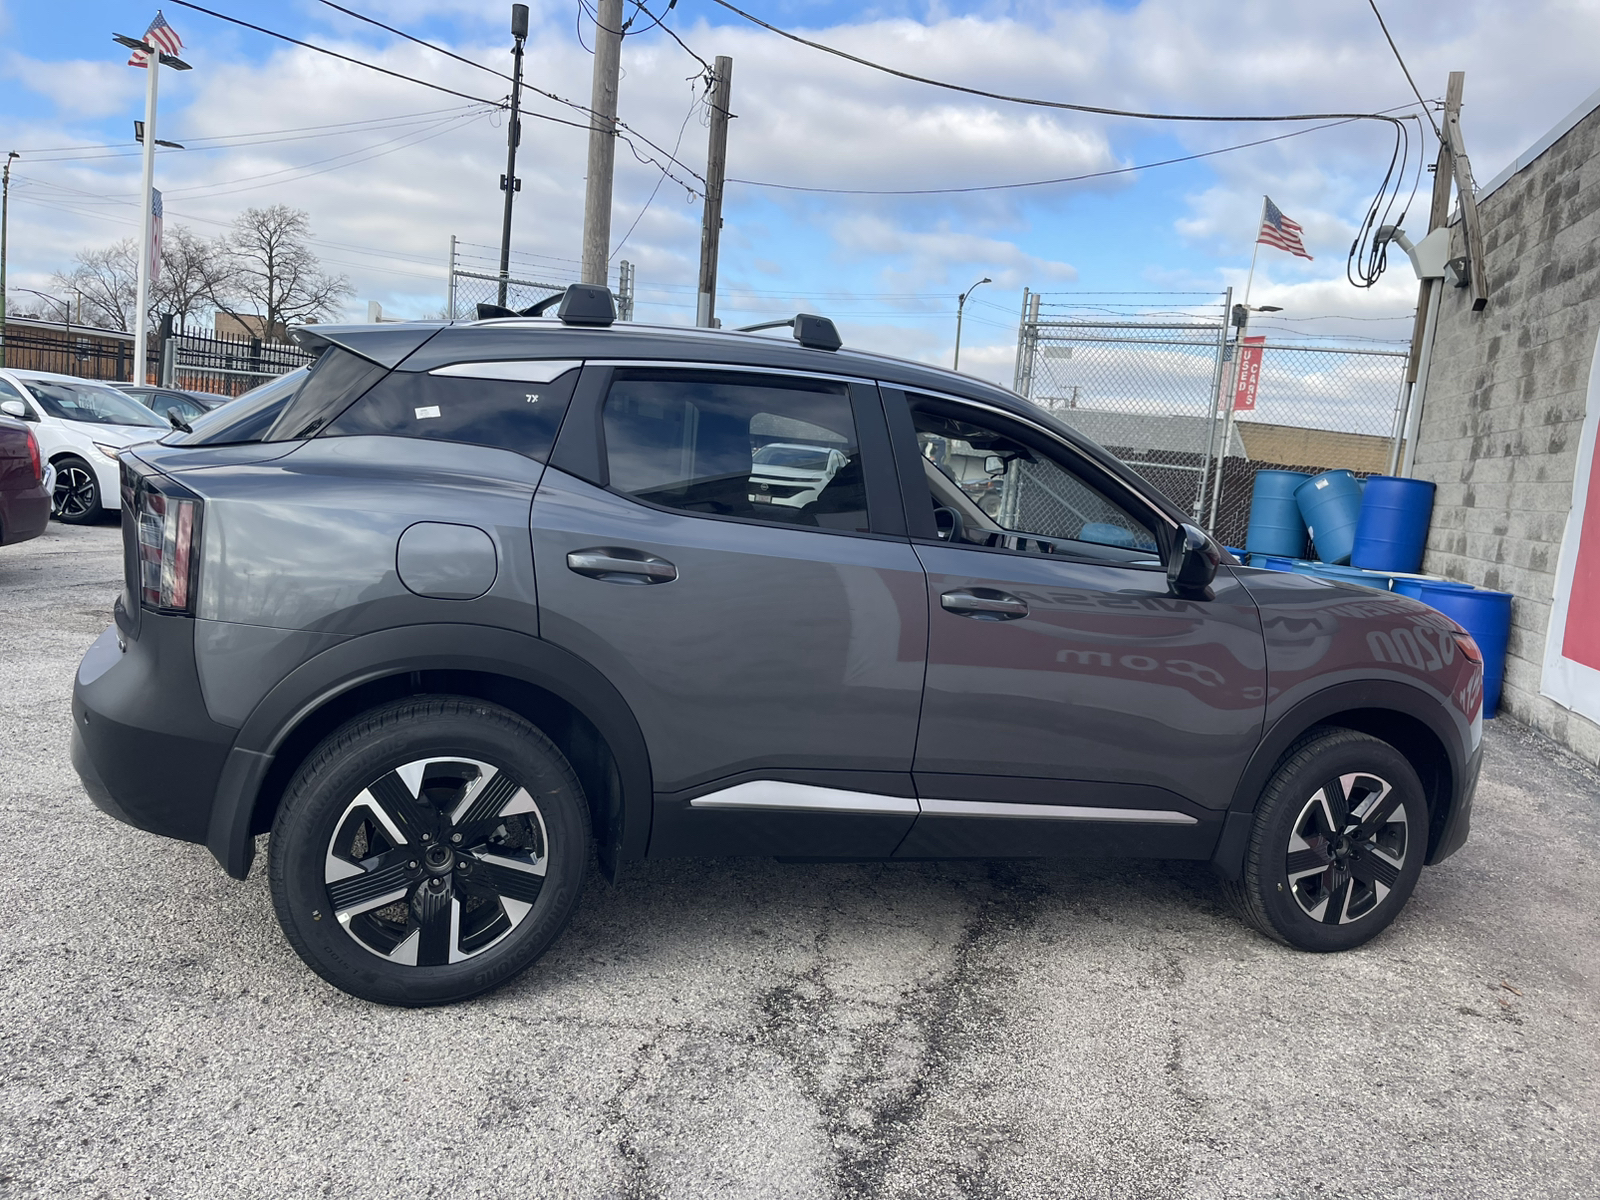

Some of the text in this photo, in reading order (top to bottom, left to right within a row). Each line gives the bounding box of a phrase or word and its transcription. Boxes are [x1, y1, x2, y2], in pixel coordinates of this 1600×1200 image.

[1239, 350, 1252, 391] USED
[1245, 363, 1258, 405] CARS
[474, 889, 571, 986] BRIDGESTONE
